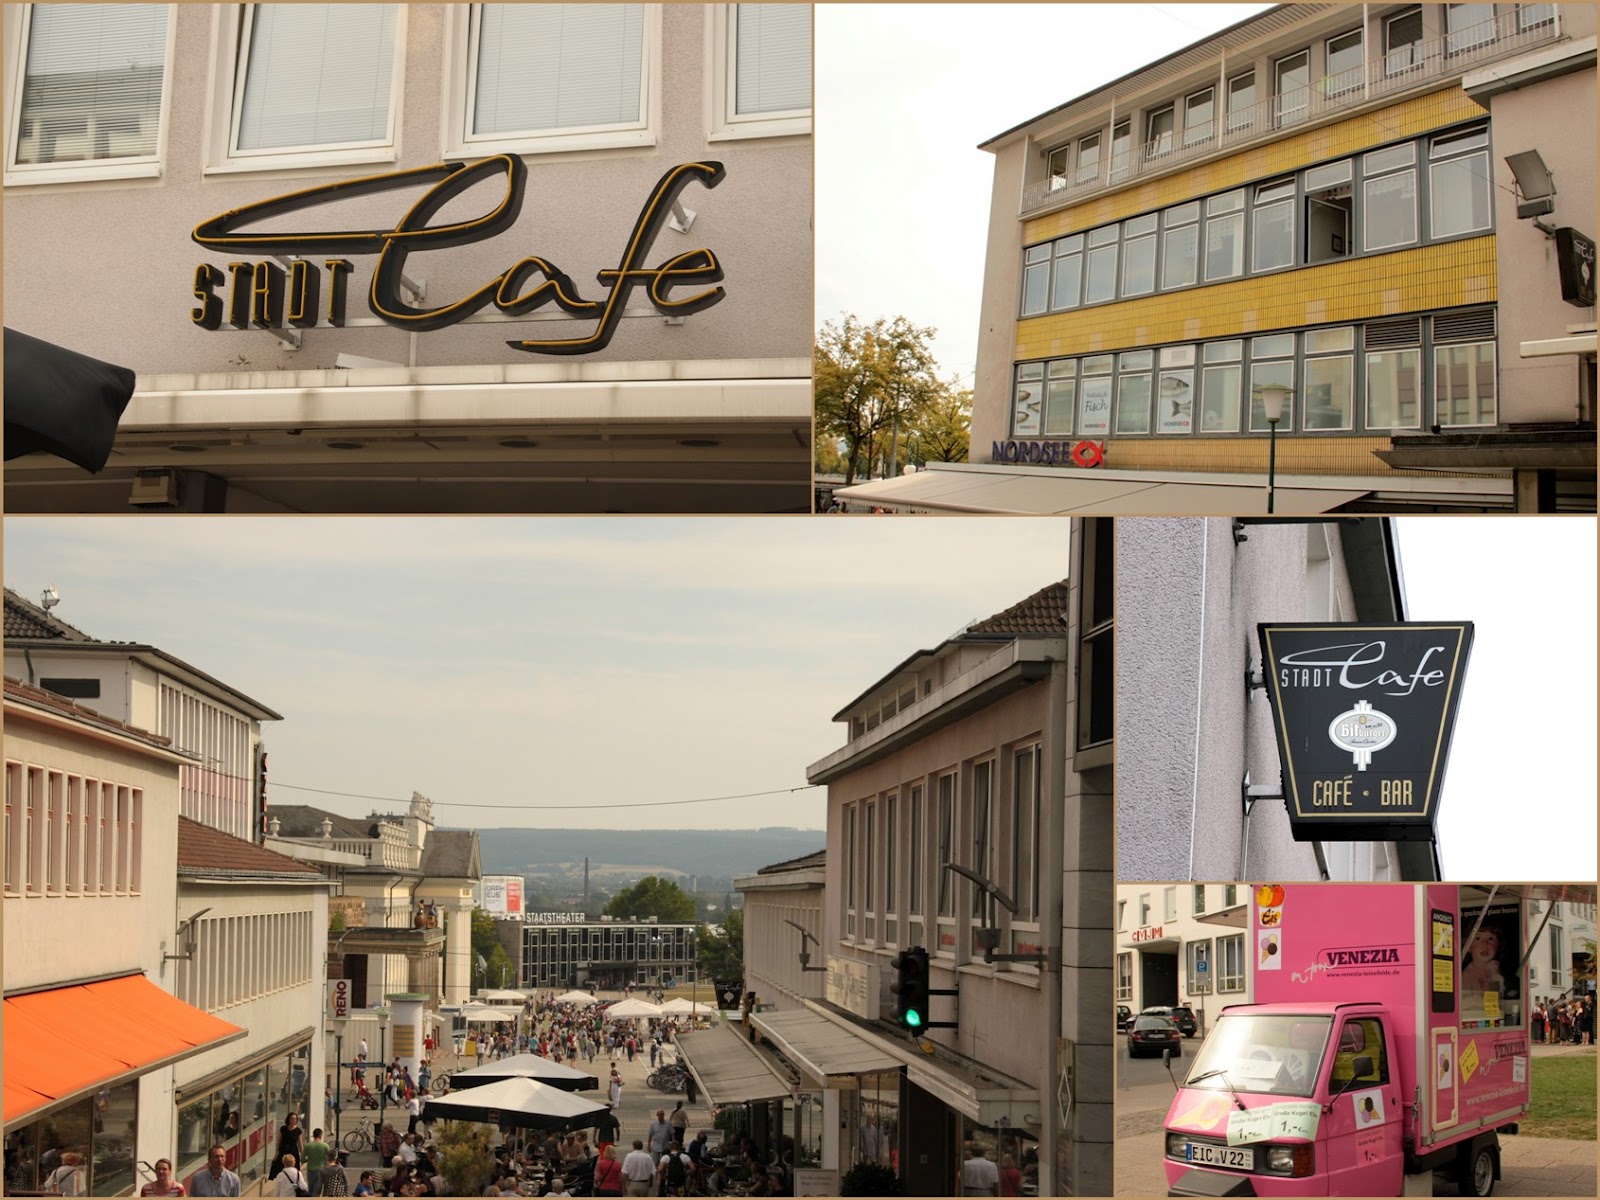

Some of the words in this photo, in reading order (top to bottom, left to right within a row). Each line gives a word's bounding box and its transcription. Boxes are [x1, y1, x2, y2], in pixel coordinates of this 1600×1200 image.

[192, 153, 726, 354] Cafe
[191, 258, 354, 331] STADT
[992, 440, 1070, 464] NORDSEE
[1280, 640, 1445, 696] Cafe
[1281, 668, 1332, 687] STADT
[1341, 723, 1386, 738] Bitburger
[1312, 775, 1353, 806] CAFÉ
[1380, 779, 1413, 806] BAR
[526, 912, 586, 924] STAATSTHEATER
[1261, 909, 1278, 926] Eis
[1327, 948, 1400, 966] VENEZIA
[336, 981, 347, 1018] RENO
[1192, 1146, 1213, 1162] EIC
[1220, 1148, 1228, 1163] V
[1229, 1151, 1245, 1166] 22
